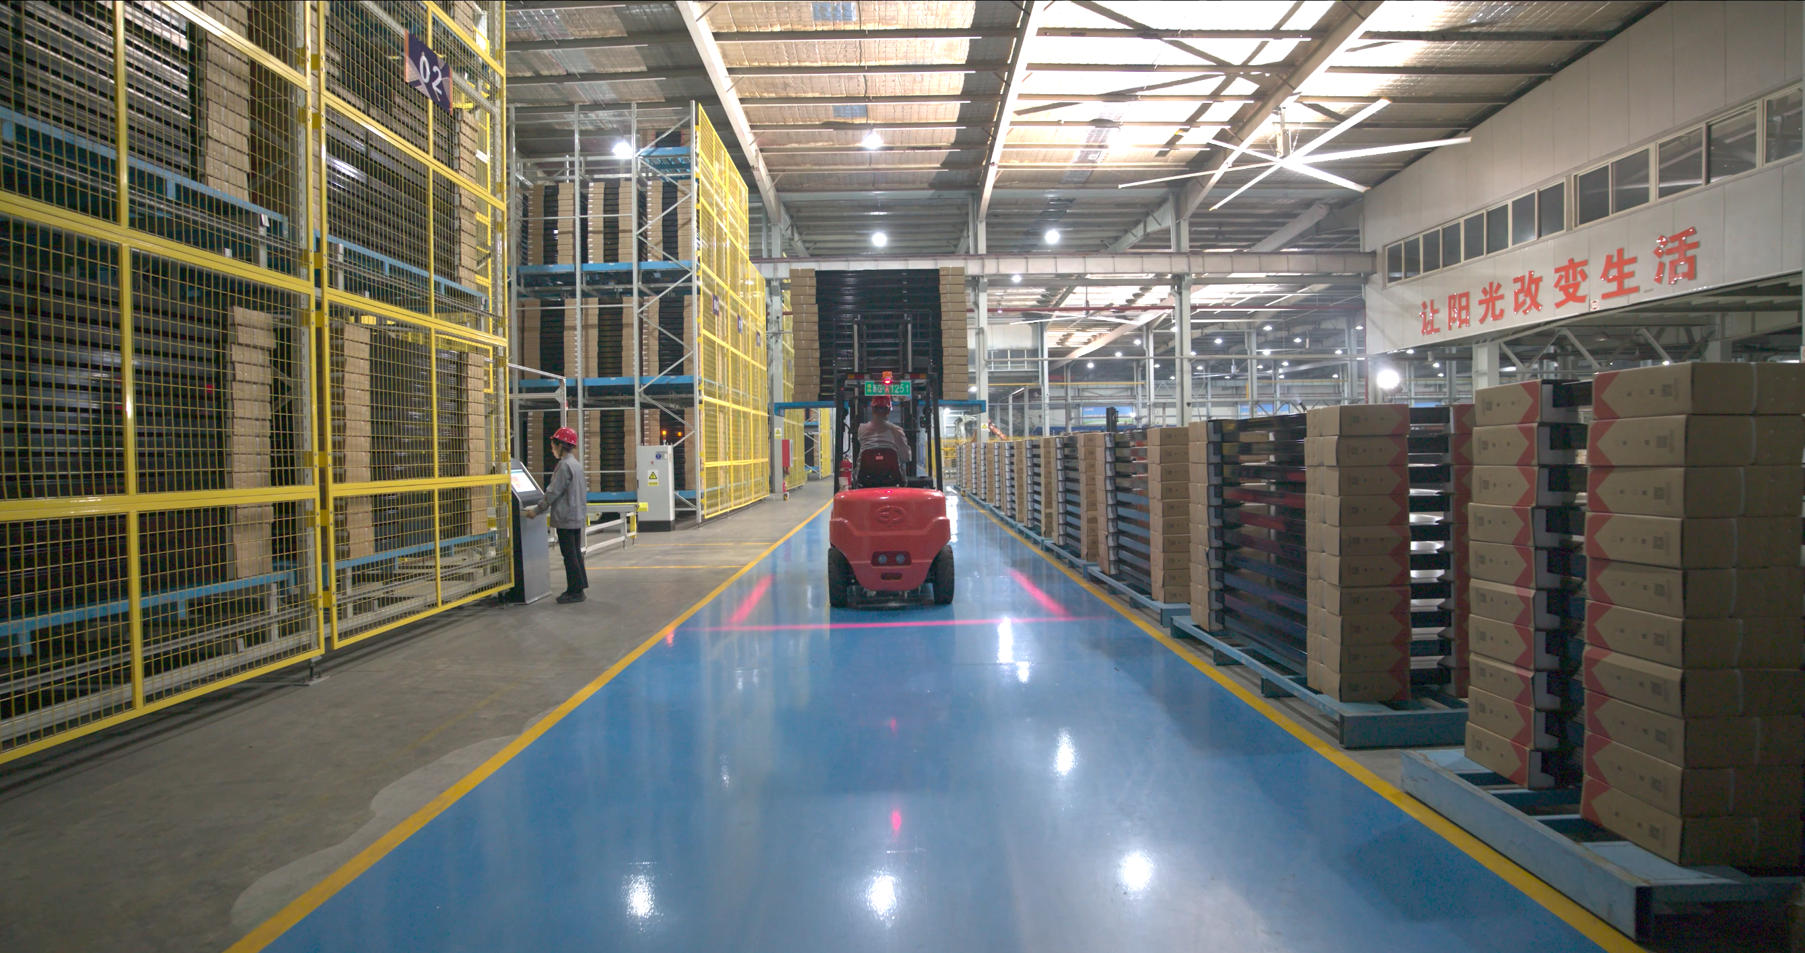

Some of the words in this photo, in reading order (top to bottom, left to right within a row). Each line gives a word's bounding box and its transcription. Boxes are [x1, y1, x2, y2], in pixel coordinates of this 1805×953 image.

[419, 55, 443, 97] 02
[1418, 226, 1701, 336] 让阳光改变生活
